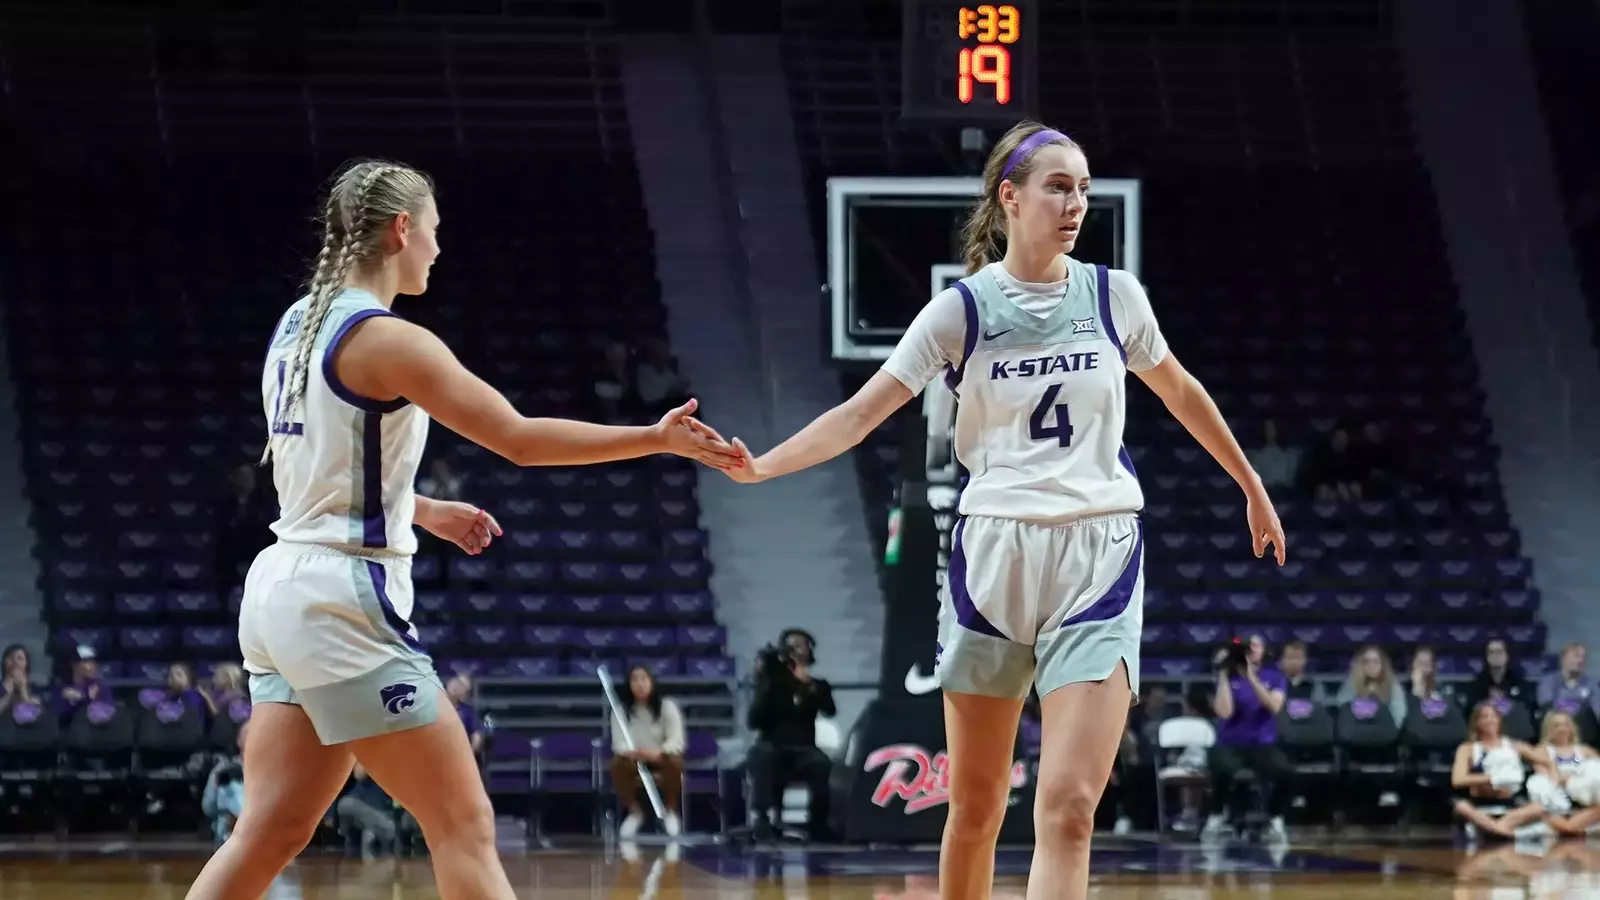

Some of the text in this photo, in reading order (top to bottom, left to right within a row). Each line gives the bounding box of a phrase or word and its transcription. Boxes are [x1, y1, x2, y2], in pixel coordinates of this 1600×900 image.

[959, 44, 1010, 104] 19
[990, 352, 1099, 380] K-STATE
[1029, 383, 1074, 447] 4
